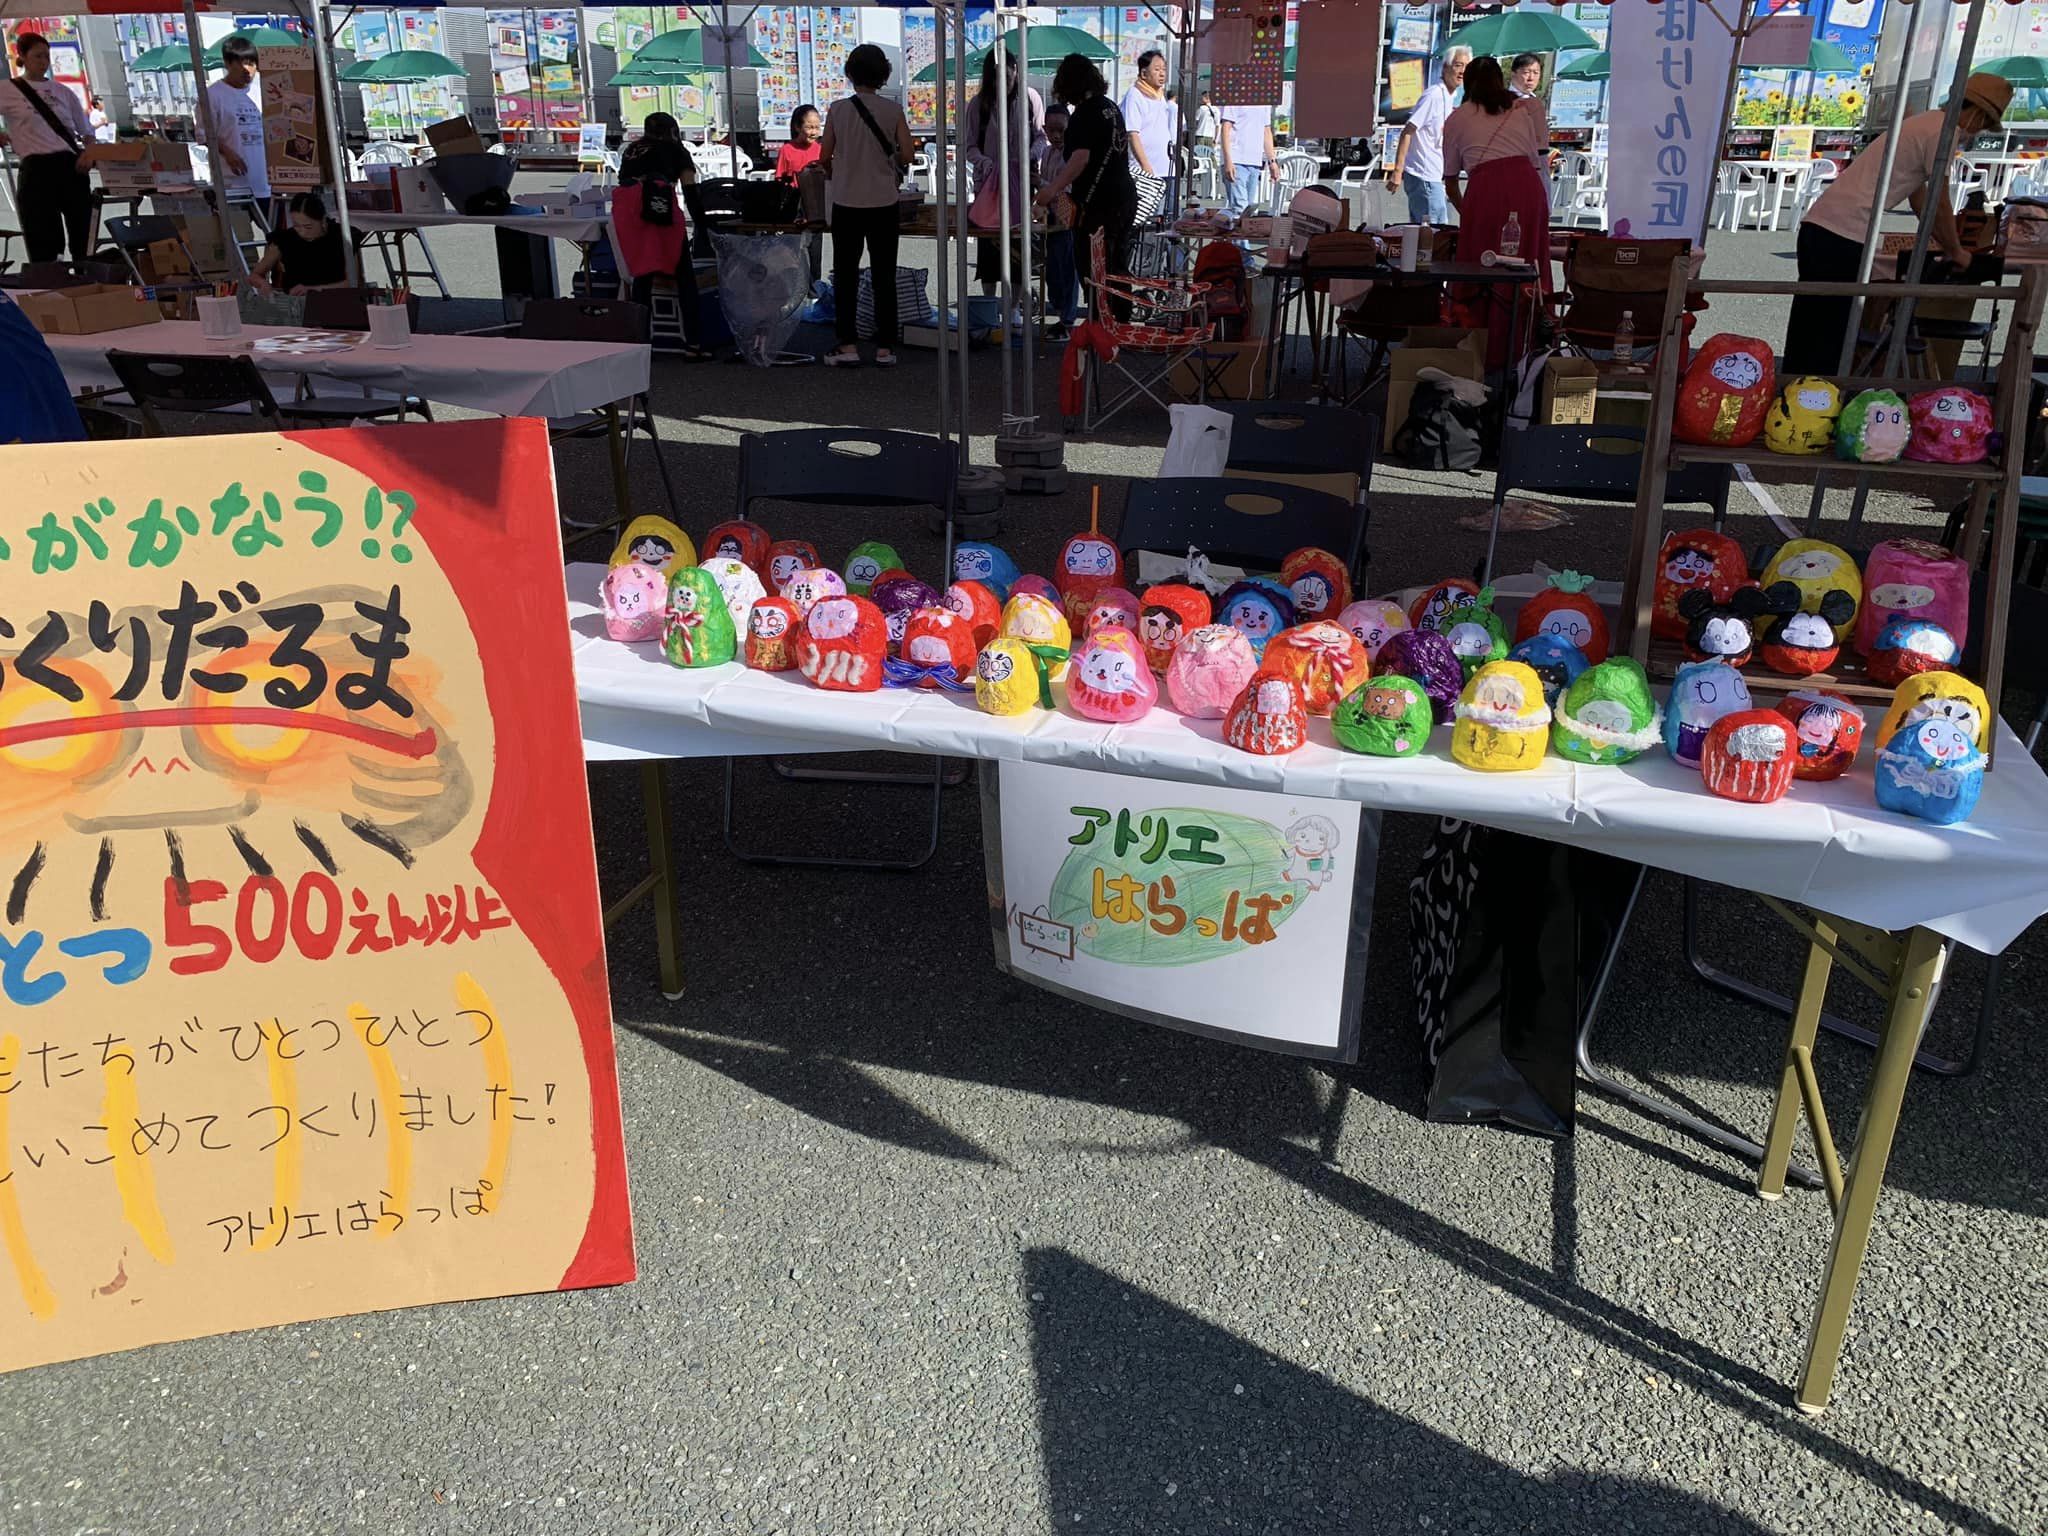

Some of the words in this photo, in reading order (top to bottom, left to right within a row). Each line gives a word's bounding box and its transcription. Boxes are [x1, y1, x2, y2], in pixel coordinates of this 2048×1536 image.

[1068, 805, 1226, 866] アトリエ
[1092, 867, 1295, 946] はらっぱ
[0, 1083, 557, 1183] いこめてつくりました!
[207, 1179, 494, 1253] アトリエはらっぱ
